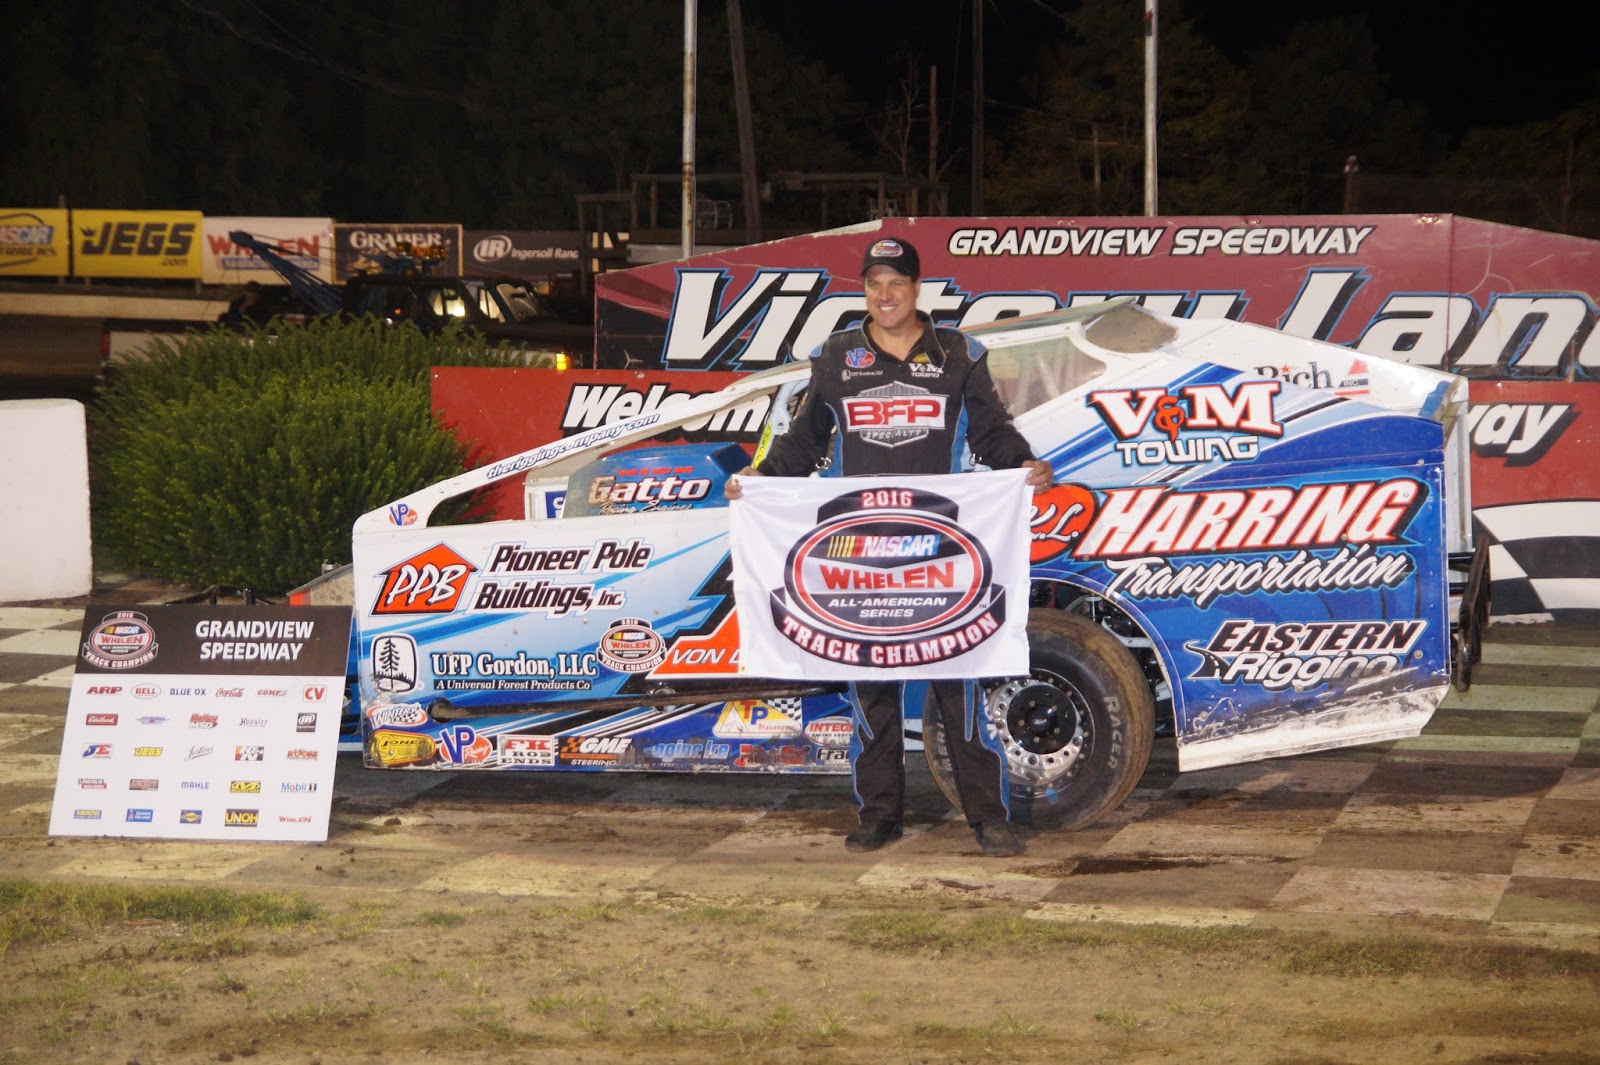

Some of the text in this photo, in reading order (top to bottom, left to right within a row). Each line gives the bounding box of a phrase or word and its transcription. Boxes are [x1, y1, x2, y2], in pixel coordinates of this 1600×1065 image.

[82, 222, 196, 256] JEGS
[948, 226, 1374, 256] GRANDVIEW SPEEDWAY
[511, 248, 553, 260] Ingersoll
[847, 400, 941, 426] BFP
[1088, 382, 1283, 439] V&M
[1116, 436, 1259, 467] TOWING
[588, 475, 713, 504] Gatto
[861, 490, 913, 508] 2016
[1075, 480, 1419, 559] HARRING
[861, 534, 936, 557] NASCAR
[489, 541, 652, 573] Pioneer Pole
[819, 561, 956, 590] WHELEN
[1105, 543, 1410, 607] Transportation
[385, 563, 468, 606] PPB
[474, 580, 594, 614] Buildings,
[828, 596, 947, 608] ALL-AMERICAN
[859, 608, 914, 618] SERIES
[115, 626, 140, 634] NASCAR
[195, 620, 315, 638] GRANDVIEW
[782, 611, 998, 665] TRACK CHAMPION
[1207, 619, 1427, 655] EASTERN
[101, 635, 142, 644] WHELEN
[611, 641, 651, 649] WHELEN
[86, 651, 154, 668] TRACK CHAMPION
[200, 642, 303, 660] SPEEDWAY
[672, 648, 727, 665] VON
[432, 653, 598, 678] UFP Gordon, LLC
[601, 656, 663, 672] TRACK CHAMPION
[86, 686, 123, 694] ARP
[304, 687, 325, 700] CV
[436, 679, 590, 690] A Universal Forest Products Co
[740, 700, 769, 725] TP
[1103, 696, 1124, 770] RACER
[440, 726, 476, 764] VP
[505, 740, 551, 750] FK
[580, 737, 632, 753] GME
[181, 782, 210, 790] MAHLE
[281, 783, 306, 791] Mobil
[225, 812, 259, 823] UNOH
